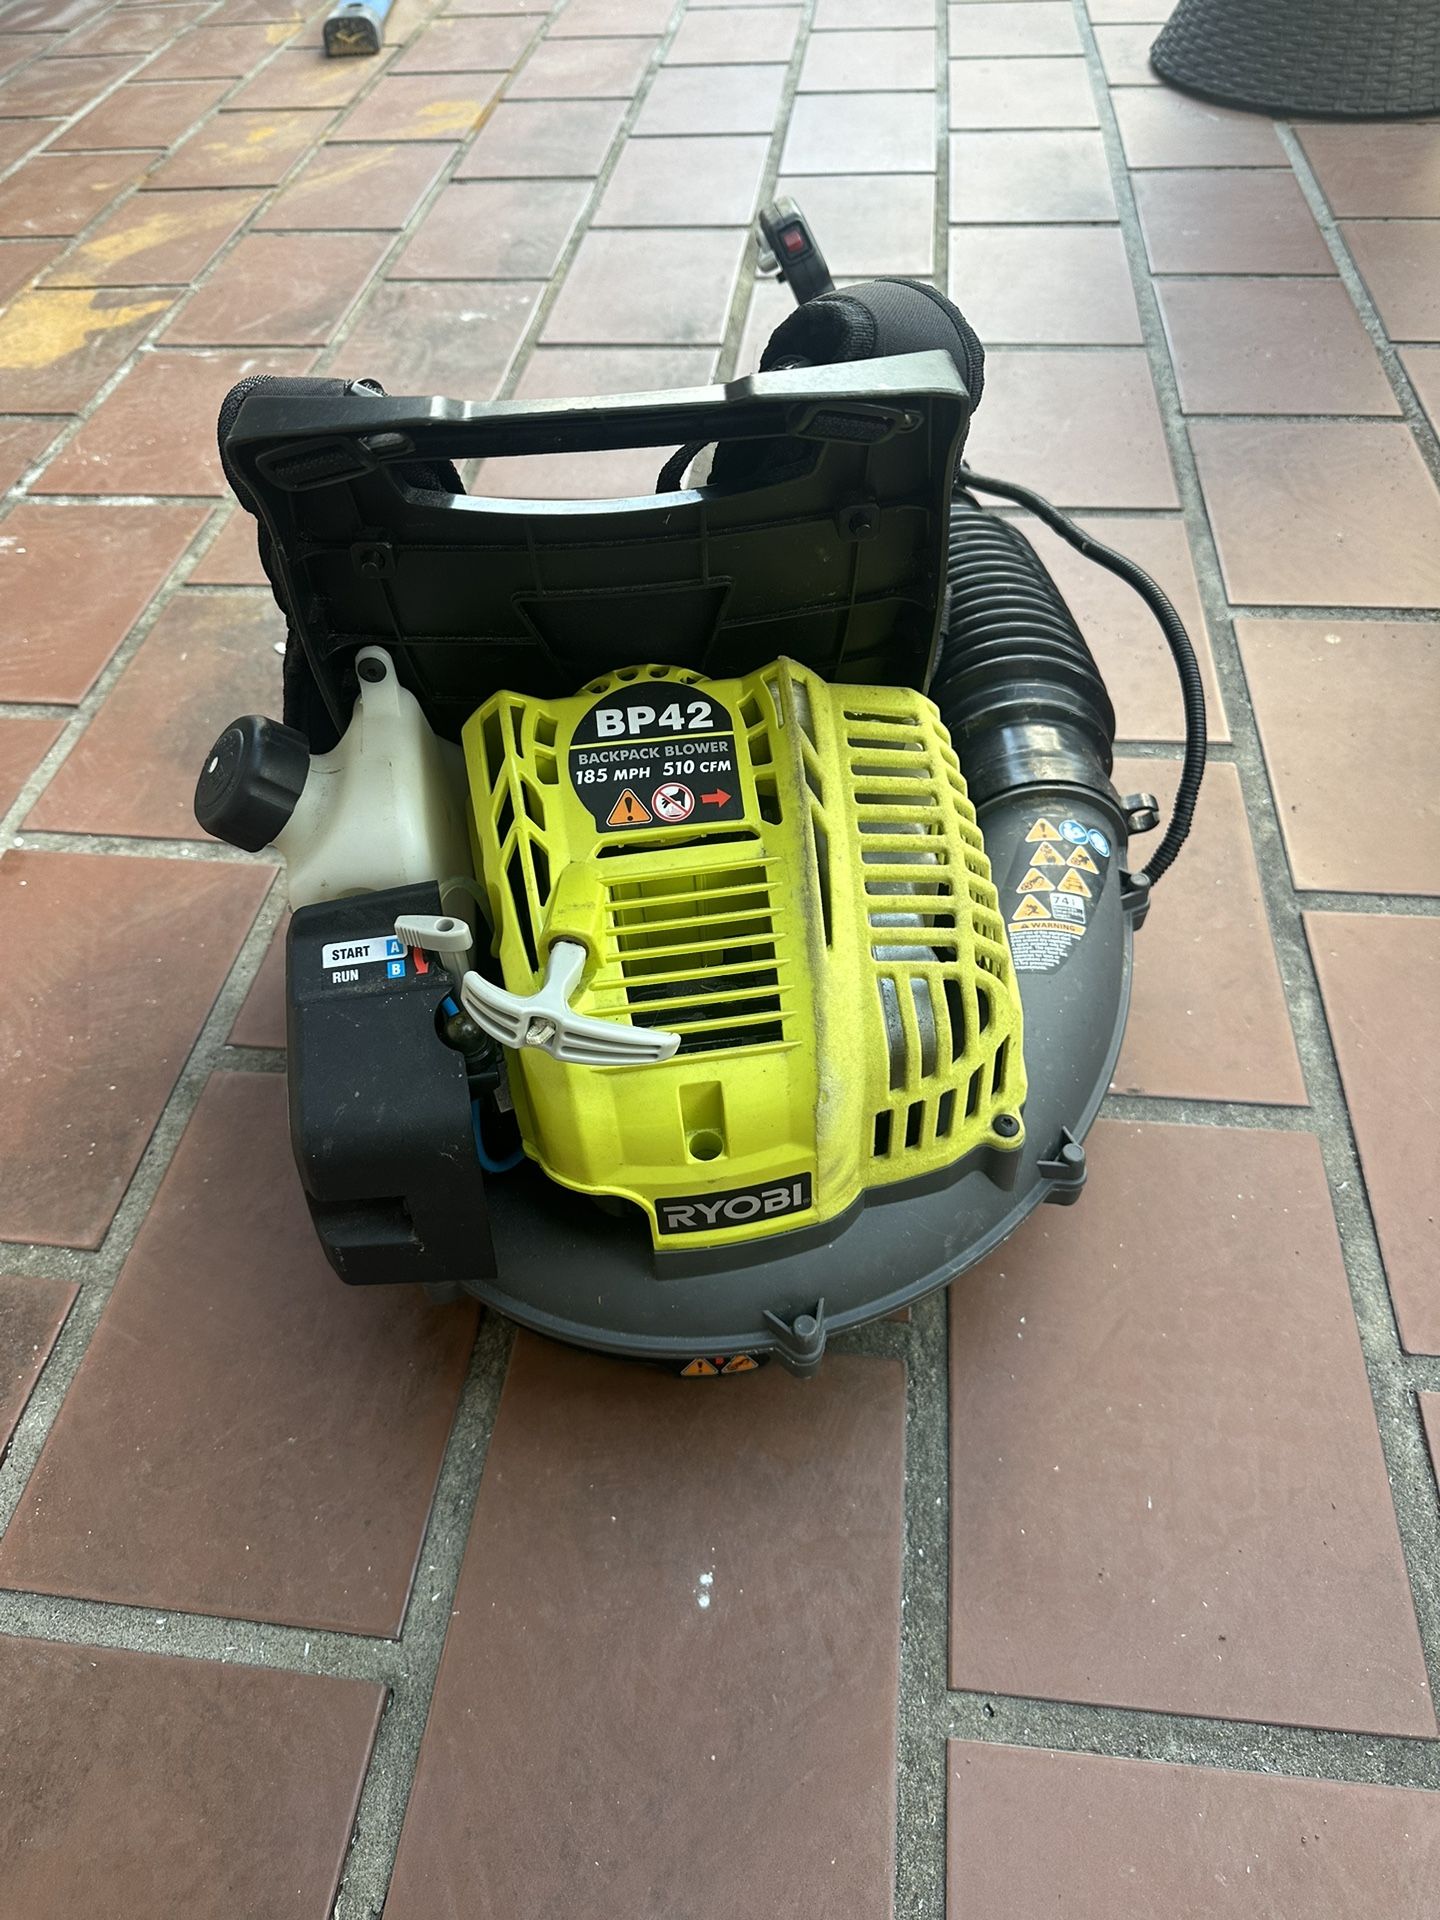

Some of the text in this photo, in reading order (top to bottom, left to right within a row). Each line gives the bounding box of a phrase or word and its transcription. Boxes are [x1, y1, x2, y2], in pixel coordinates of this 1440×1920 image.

[595, 701, 714, 737] BP42
[578, 741, 729, 765] BACKPACK BLOWER
[576, 760, 732, 785] 185 MPH 510 CFM
[1030, 922, 1076, 932] WARNING
[332, 941, 400, 961] START A
[332, 963, 401, 984] RUN B
[663, 1183, 802, 1228] RYOBI
